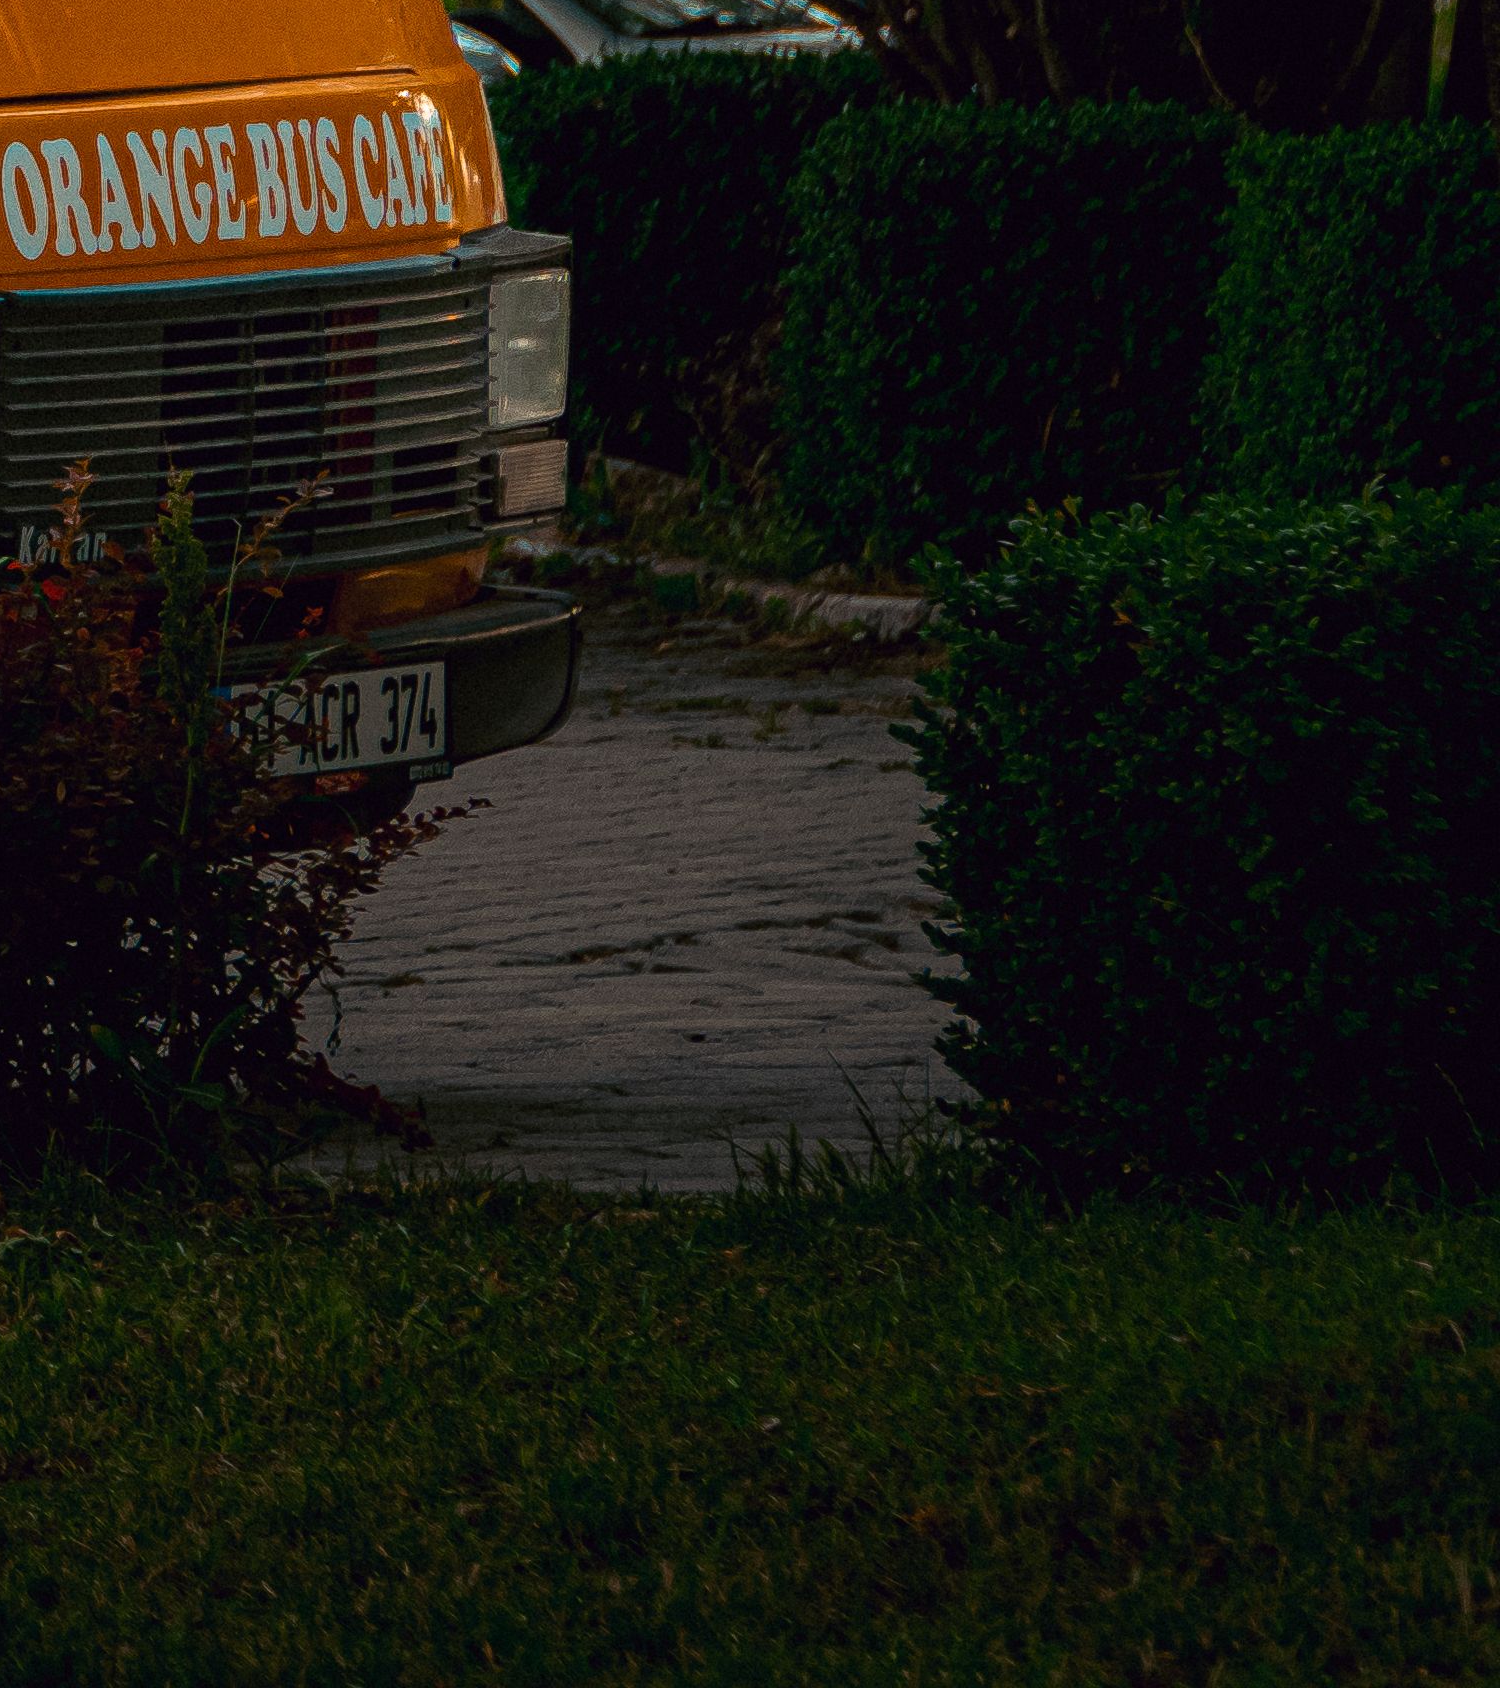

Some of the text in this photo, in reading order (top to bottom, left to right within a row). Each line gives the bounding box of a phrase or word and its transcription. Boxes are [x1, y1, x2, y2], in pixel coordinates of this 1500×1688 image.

[1, 108, 454, 262] ORANGE BUS CAFE
[298, 679, 361, 766] ACR
[380, 671, 438, 755] 374
